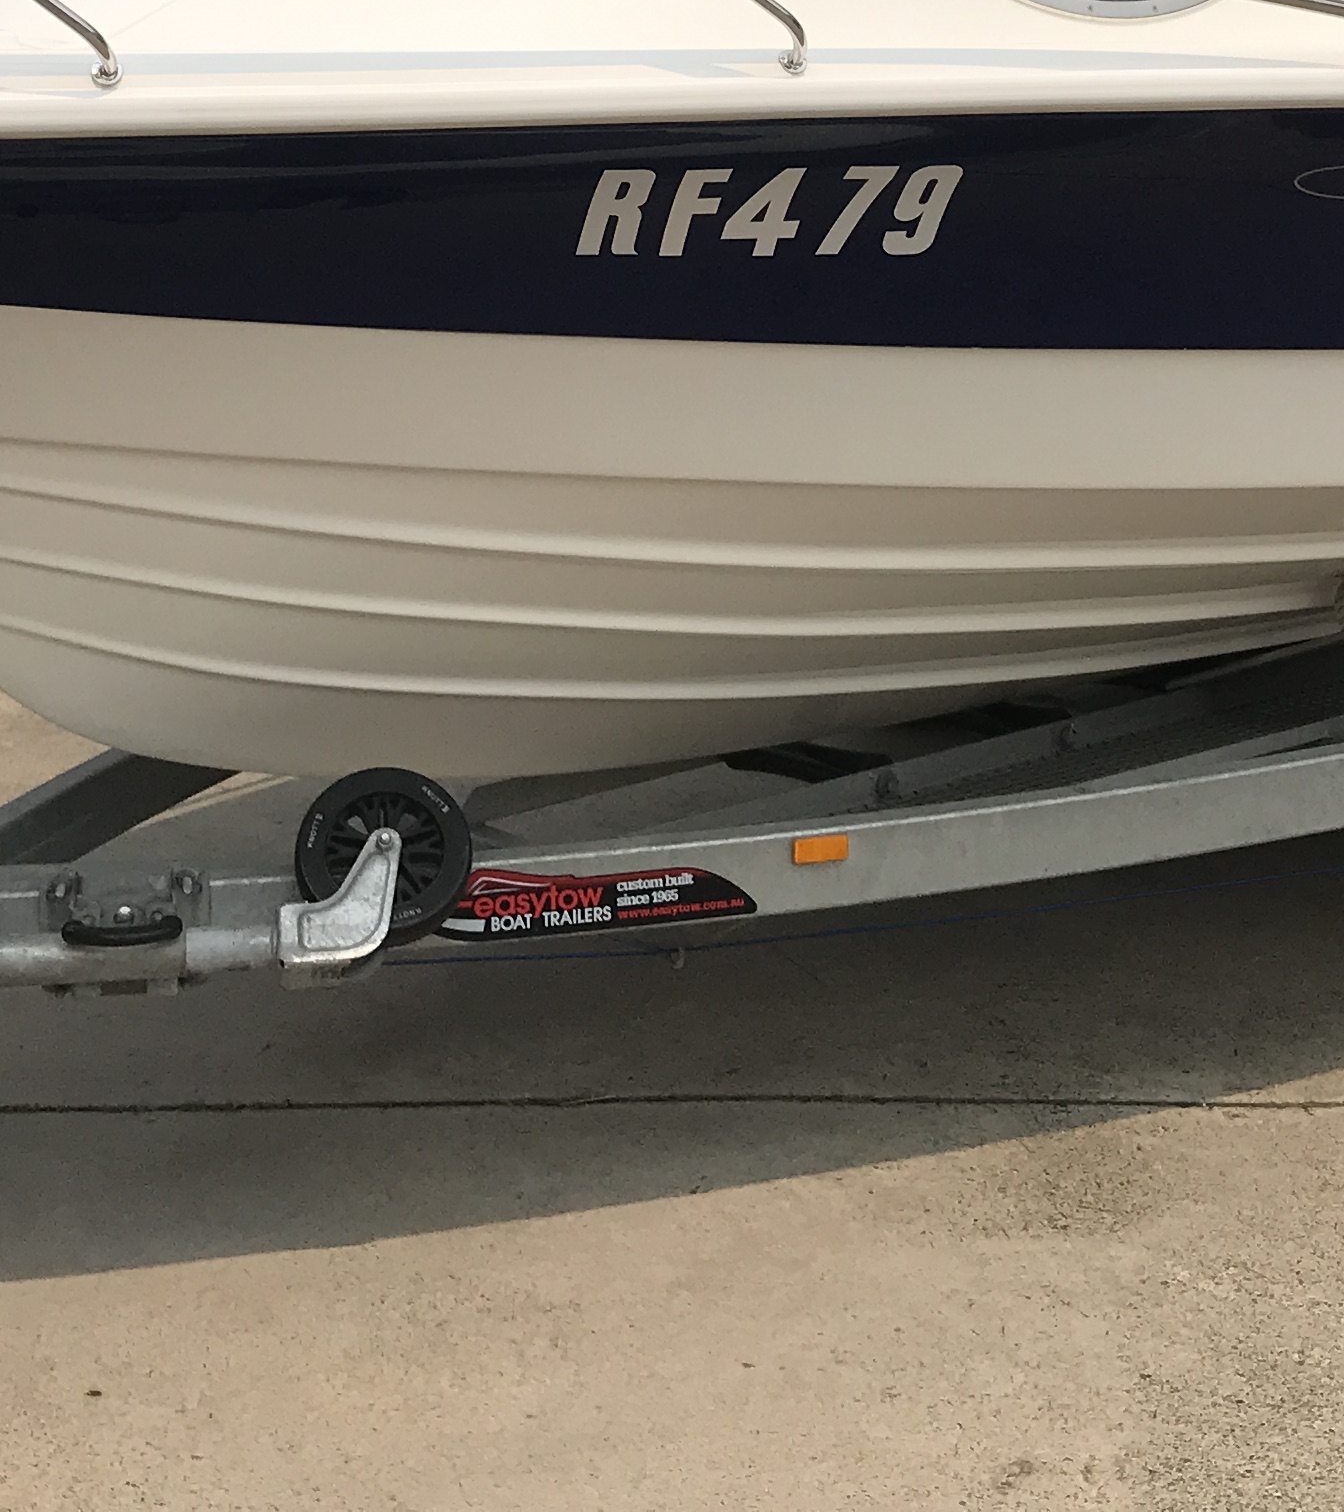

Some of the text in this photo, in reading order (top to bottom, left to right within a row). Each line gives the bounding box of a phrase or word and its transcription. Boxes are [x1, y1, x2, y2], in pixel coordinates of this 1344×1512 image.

[616, 872, 694, 892] custom built
[474, 886, 604, 919] easytow
[616, 889, 679, 907] since 1965
[490, 906, 612, 933] BOAT TRAILERS
